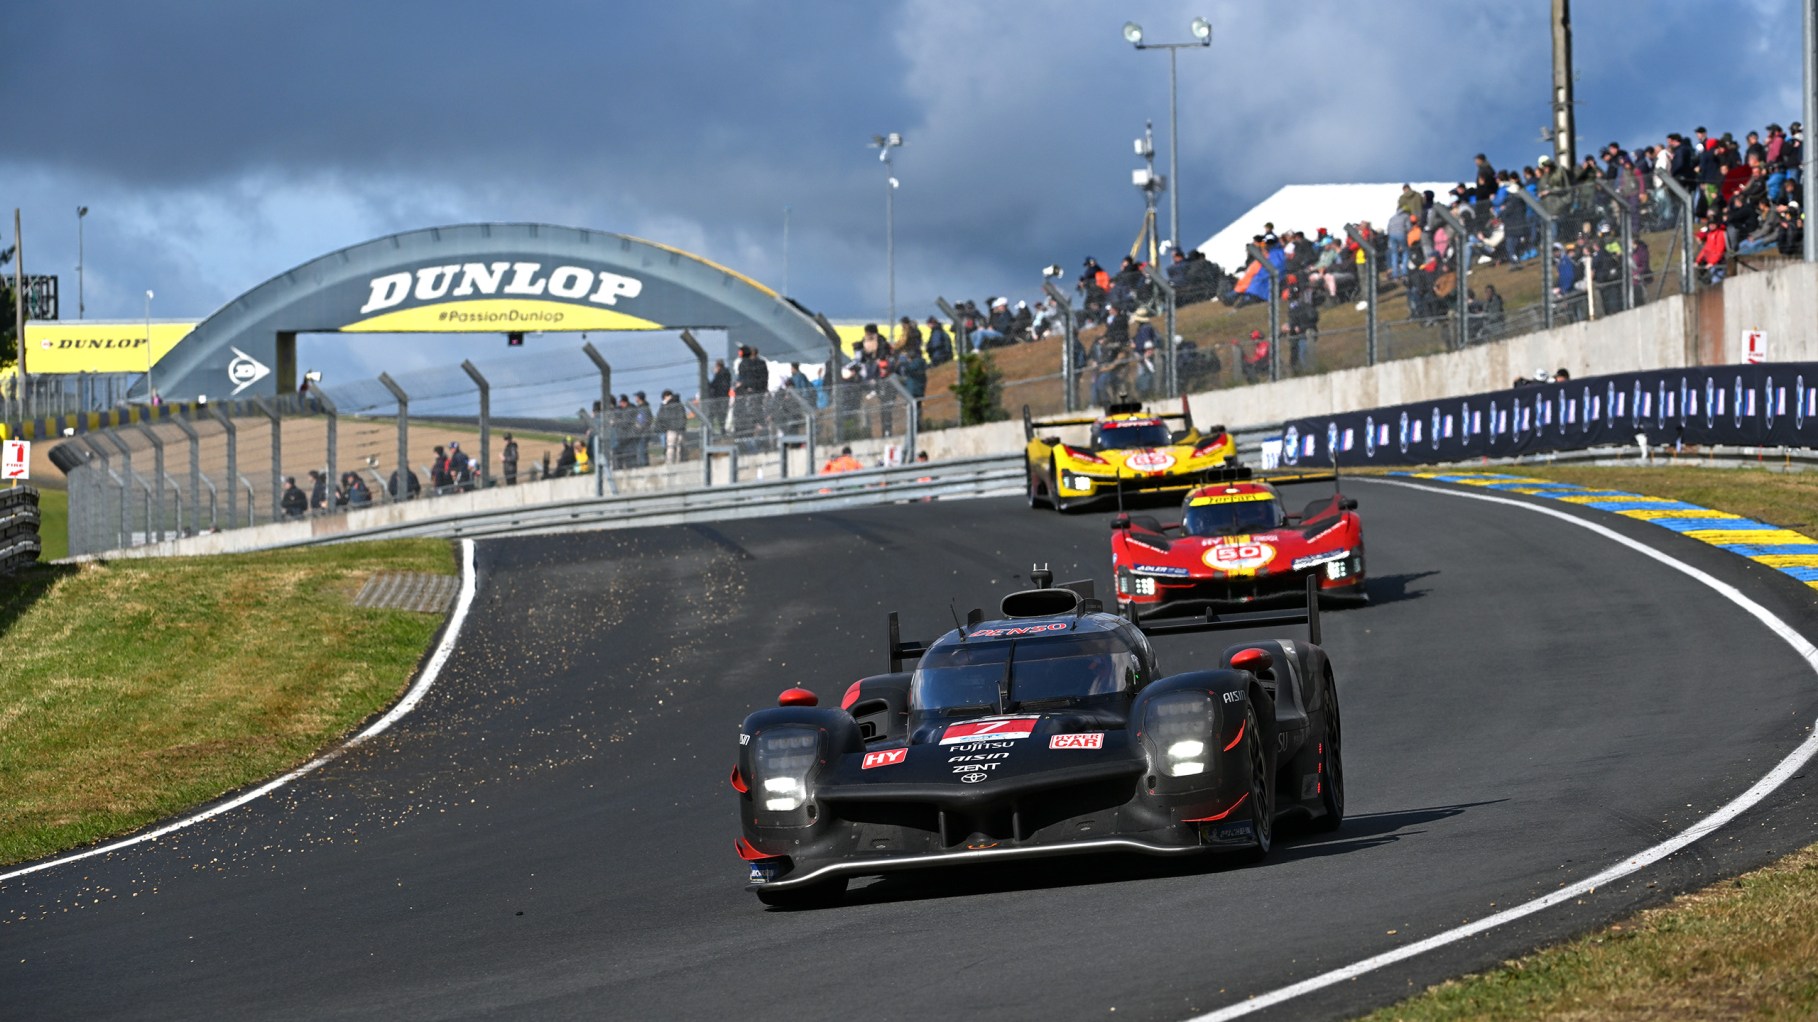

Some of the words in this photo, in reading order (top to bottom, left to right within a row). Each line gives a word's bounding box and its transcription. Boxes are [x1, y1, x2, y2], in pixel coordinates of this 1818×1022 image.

[360, 262, 642, 314] DUNLOP
[438, 309, 565, 324] #PassionDunlop
[57, 338, 148, 350] DUNLOP
[1218, 546, 1260, 560] 50
[969, 623, 1067, 638] DENSO
[972, 721, 1011, 735] 7
[949, 741, 1015, 752] FUJITSU
[1054, 738, 1098, 747] CAR
[866, 750, 903, 766] HY
[952, 762, 1001, 774] ZENT
